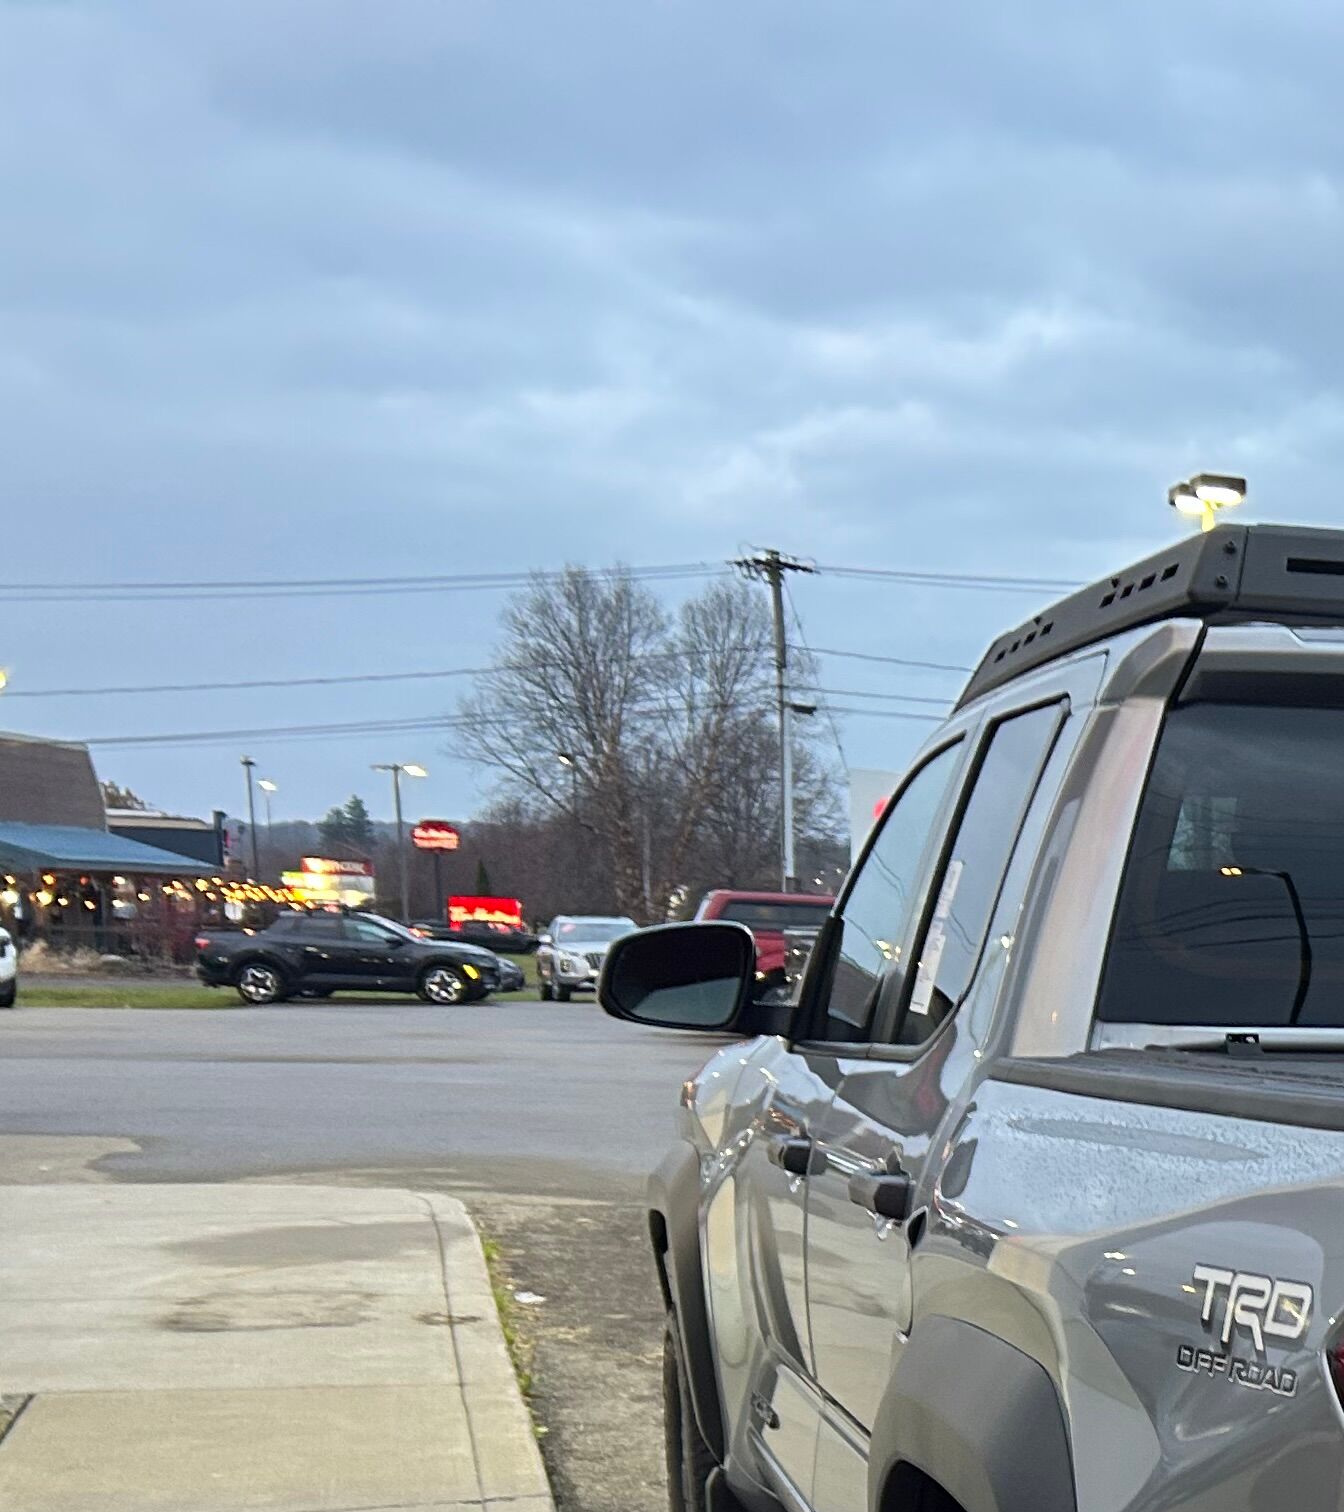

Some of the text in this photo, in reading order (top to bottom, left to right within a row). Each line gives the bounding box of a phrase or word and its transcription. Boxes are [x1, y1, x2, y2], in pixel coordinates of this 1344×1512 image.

[1192, 1263, 1314, 1352] TRD
[1176, 1343, 1299, 1398] OFF ROAD
